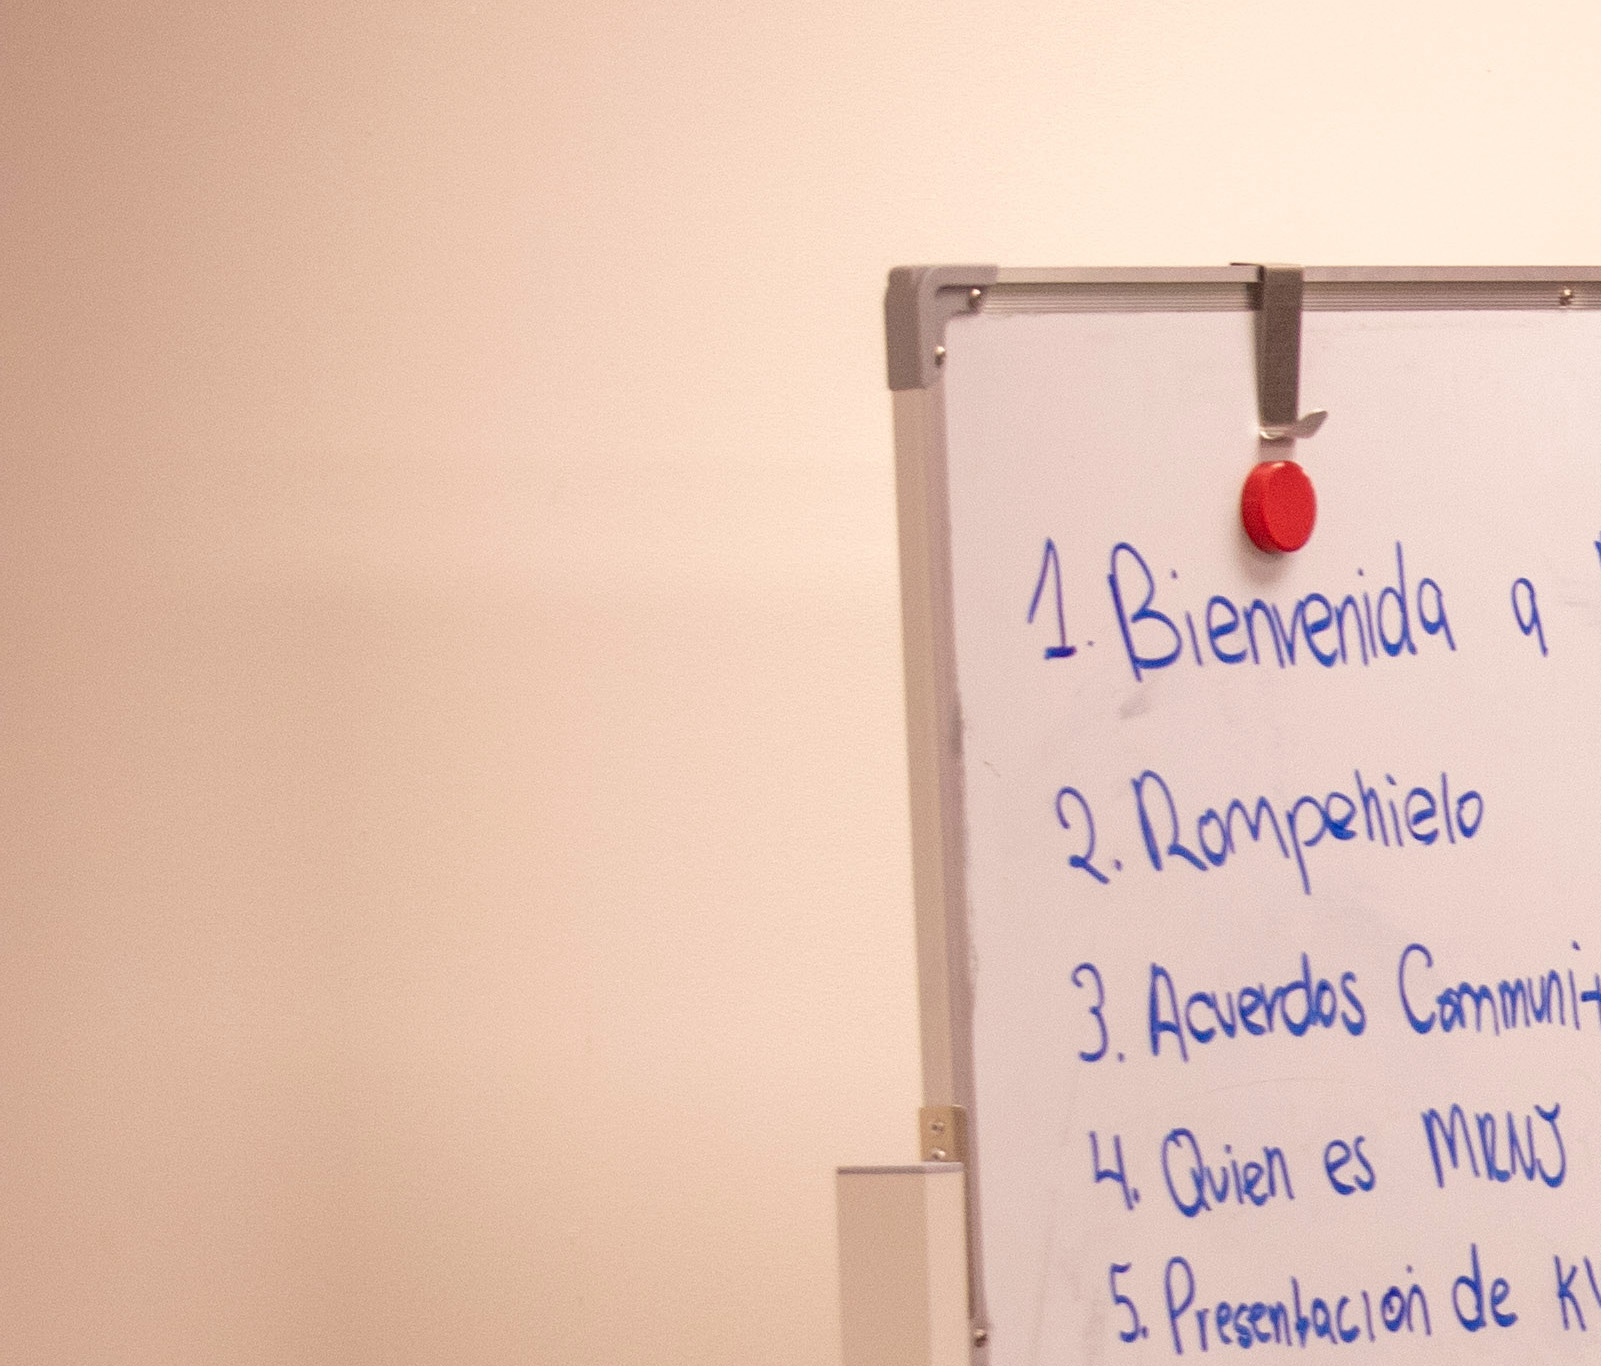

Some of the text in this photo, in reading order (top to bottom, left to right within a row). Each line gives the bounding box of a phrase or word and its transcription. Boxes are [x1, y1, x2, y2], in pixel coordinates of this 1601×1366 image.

[1108, 541, 1456, 682] Bienvenida
[1510, 577, 1548, 656] a
[1131, 770, 1485, 896] Rompehielo
[1148, 953, 1368, 1064] Acuerdos
[1160, 1127, 1295, 1218] Quien
[1323, 1133, 1377, 1196] es
[1421, 1101, 1567, 1190] MRNJ
[1451, 1241, 1519, 1334] de
